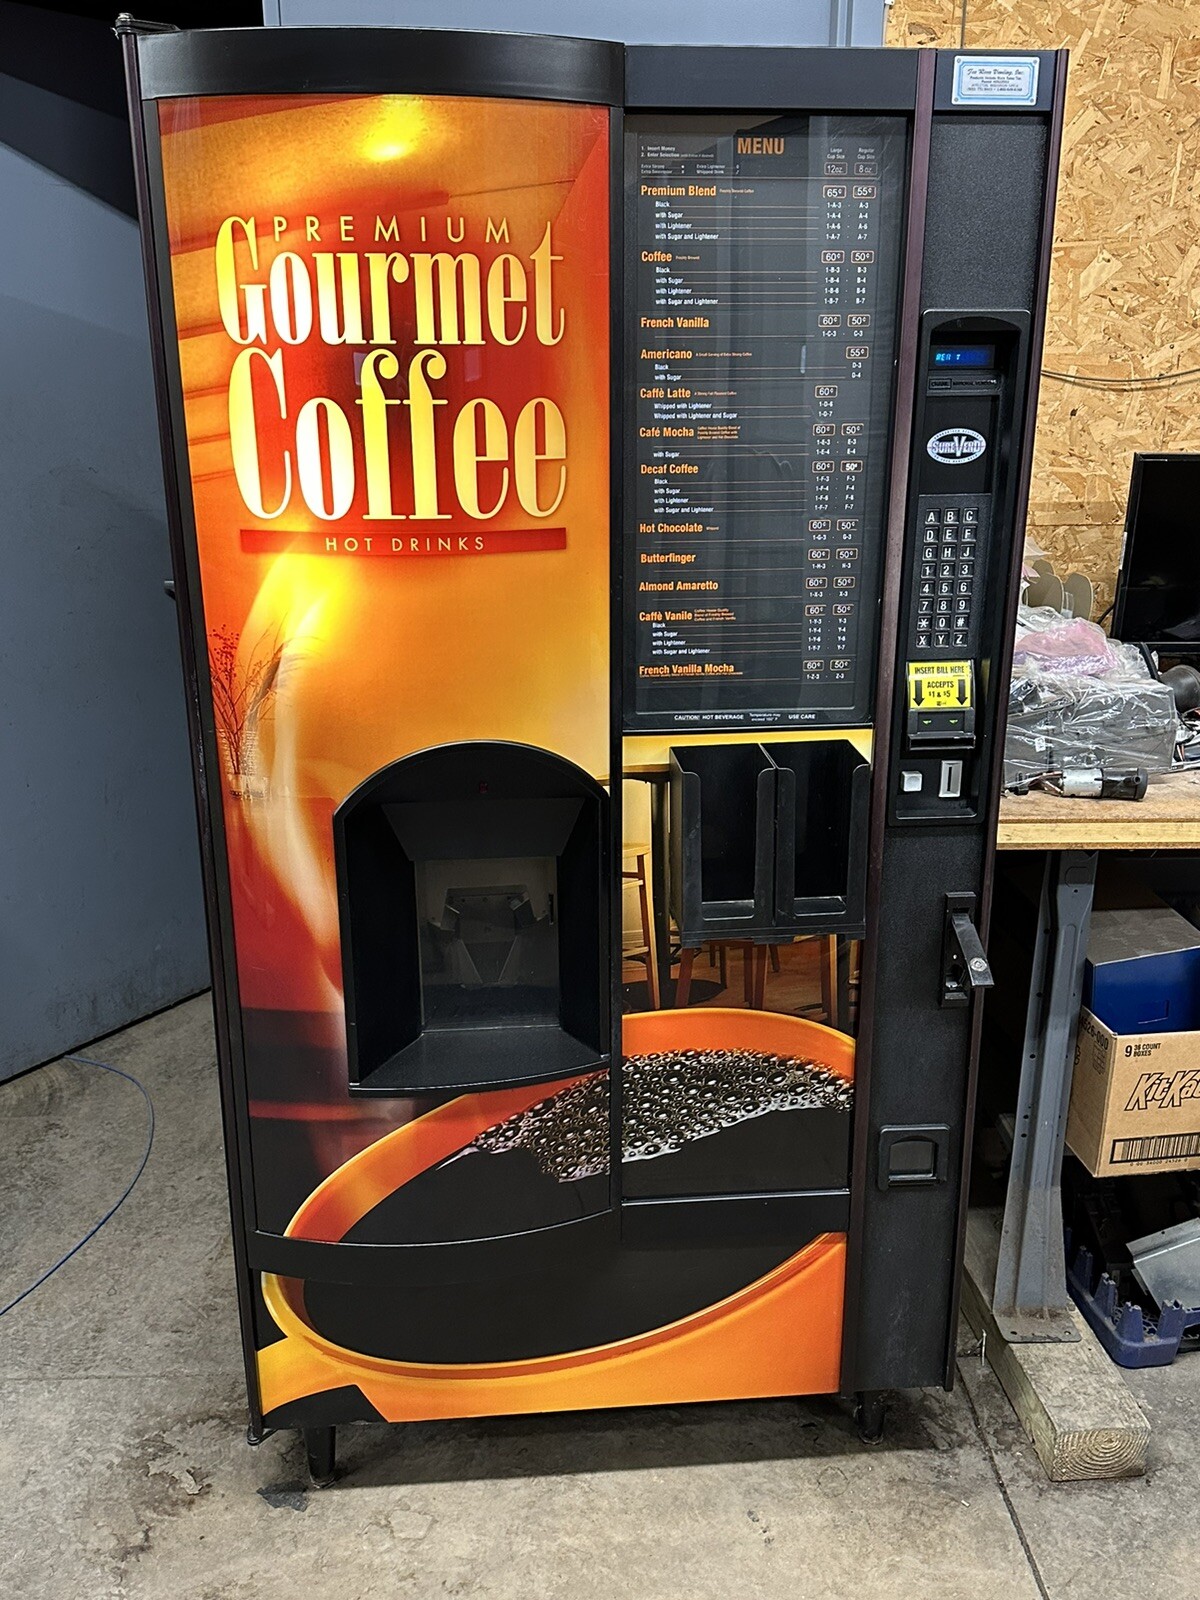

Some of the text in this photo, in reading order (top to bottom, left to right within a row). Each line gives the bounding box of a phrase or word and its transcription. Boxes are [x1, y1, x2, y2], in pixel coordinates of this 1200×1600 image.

[737, 137, 785, 154] MENU
[641, 185, 686, 196] Premium
[688, 185, 716, 196] Blend
[273, 215, 510, 244] PREMIUM
[641, 251, 672, 262] Coffee
[215, 215, 565, 346] Gourmet
[641, 317, 709, 328] French Vanilla
[640, 349, 692, 359] Americano
[640, 388, 664, 398] Caffè
[668, 388, 691, 398] Latte
[228, 346, 567, 521] Coffee
[640, 427, 660, 437] Café
[663, 427, 694, 436] Mocha
[640, 464, 698, 474] Decaf Coffee
[928, 512, 935, 522] A
[946, 512, 954, 522] B
[966, 510, 973, 520] C
[640, 524, 655, 532] Hot
[658, 523, 703, 532] Chocolate
[926, 530, 934, 540] D
[946, 530, 952, 540] E
[964, 529, 971, 538] F
[326, 536, 485, 552] HOT DRINKS
[926, 548, 932, 558] G
[944, 548, 952, 558] H
[963, 546, 970, 556] J
[640, 553, 696, 564] Butterfinger
[925, 566, 930, 576] 1
[942, 566, 950, 575] 2
[962, 564, 968, 574] 3
[640, 581, 718, 591] Almond Amaretto
[922, 584, 930, 593] 4
[942, 583, 948, 592] 5
[960, 582, 967, 592] 6
[922, 602, 928, 610] 7
[940, 600, 946, 610] 8
[959, 600, 966, 610] 9
[640, 611, 662, 621] Caffè
[665, 611, 692, 620] Vanile
[939, 618, 946, 628] 0
[919, 636, 926, 645] X
[938, 635, 944, 644] Y
[956, 634, 962, 644] Z
[640, 665, 670, 674] French
[672, 664, 702, 674] Vanilla
[704, 664, 734, 673] Mocha
[914, 666, 964, 674] INSERT BILL HERE
[1124, 1044, 1132, 1058] 9
